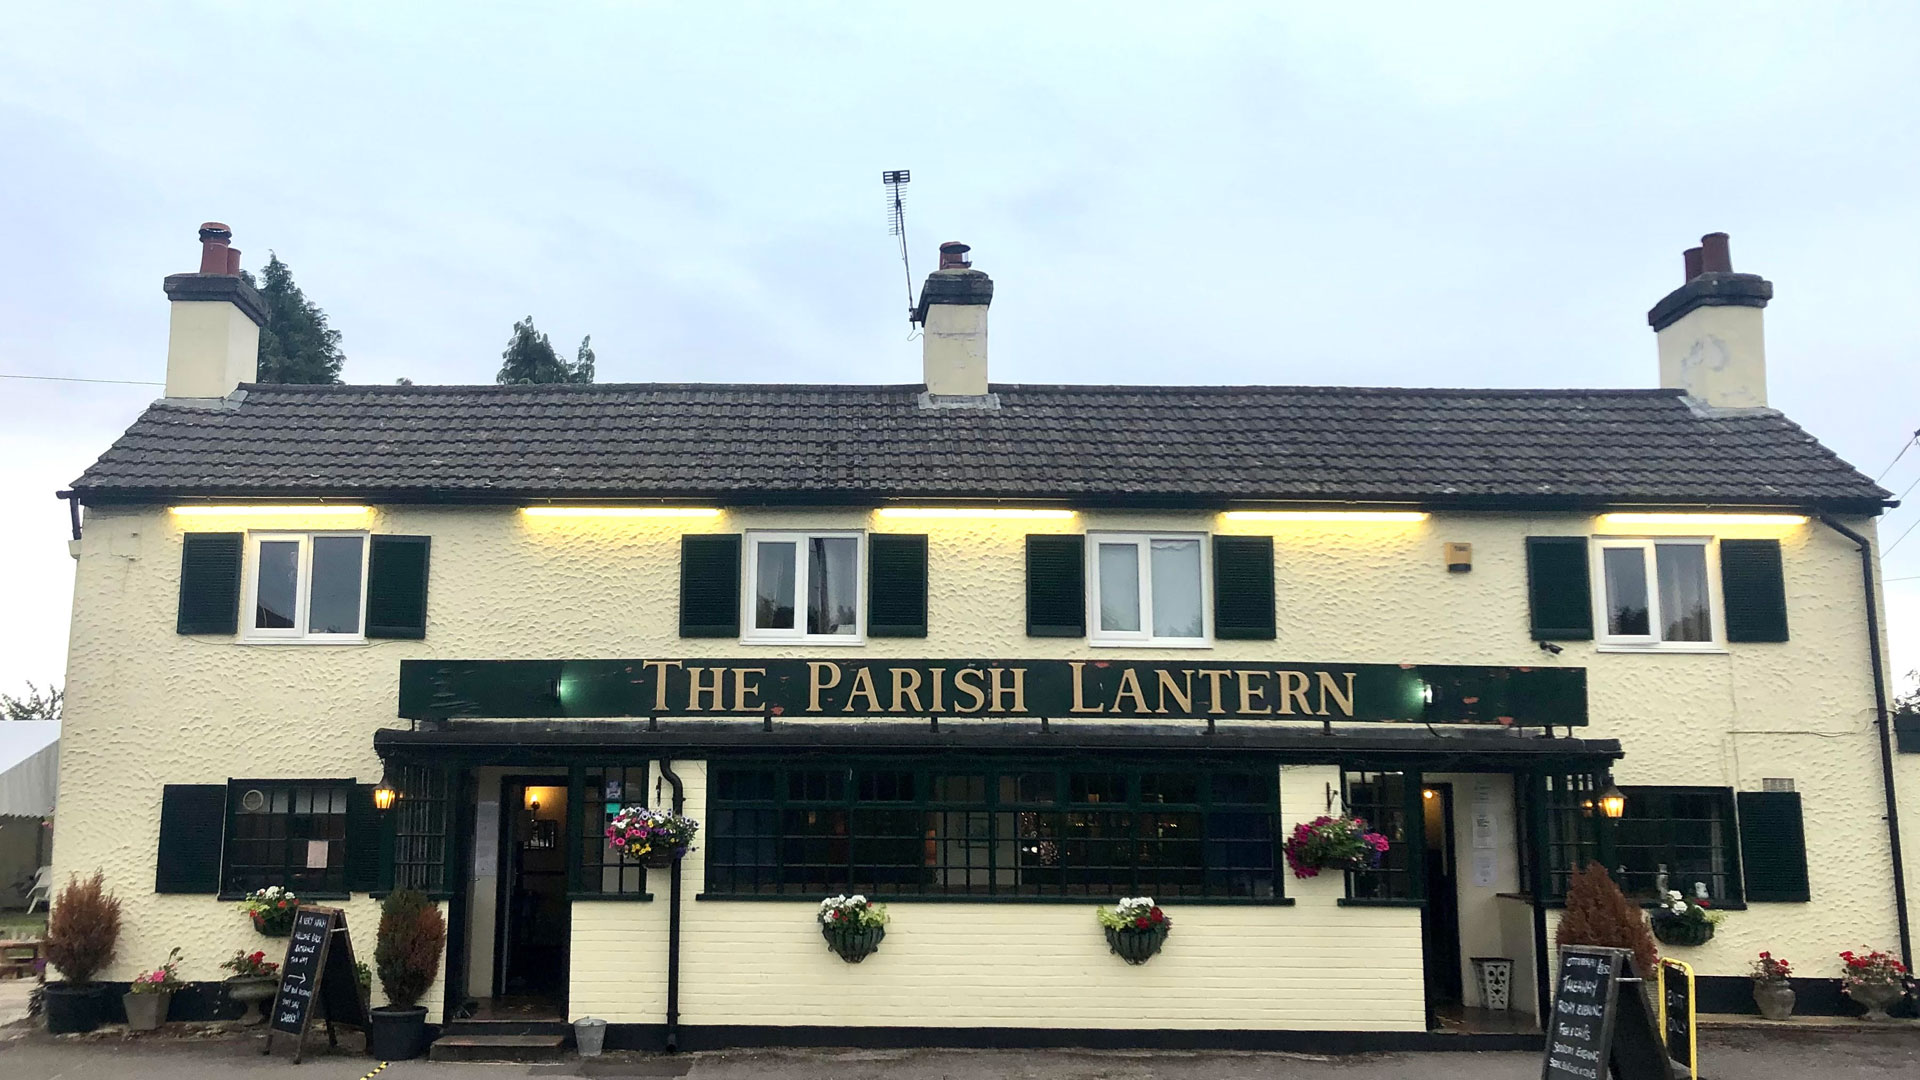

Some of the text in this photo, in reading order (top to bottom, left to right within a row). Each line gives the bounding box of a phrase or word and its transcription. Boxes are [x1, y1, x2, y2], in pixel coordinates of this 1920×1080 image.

[642, 659, 1358, 717] THE PARISH LANTERN
[1562, 974, 1598, 997] TAKEAWAY
